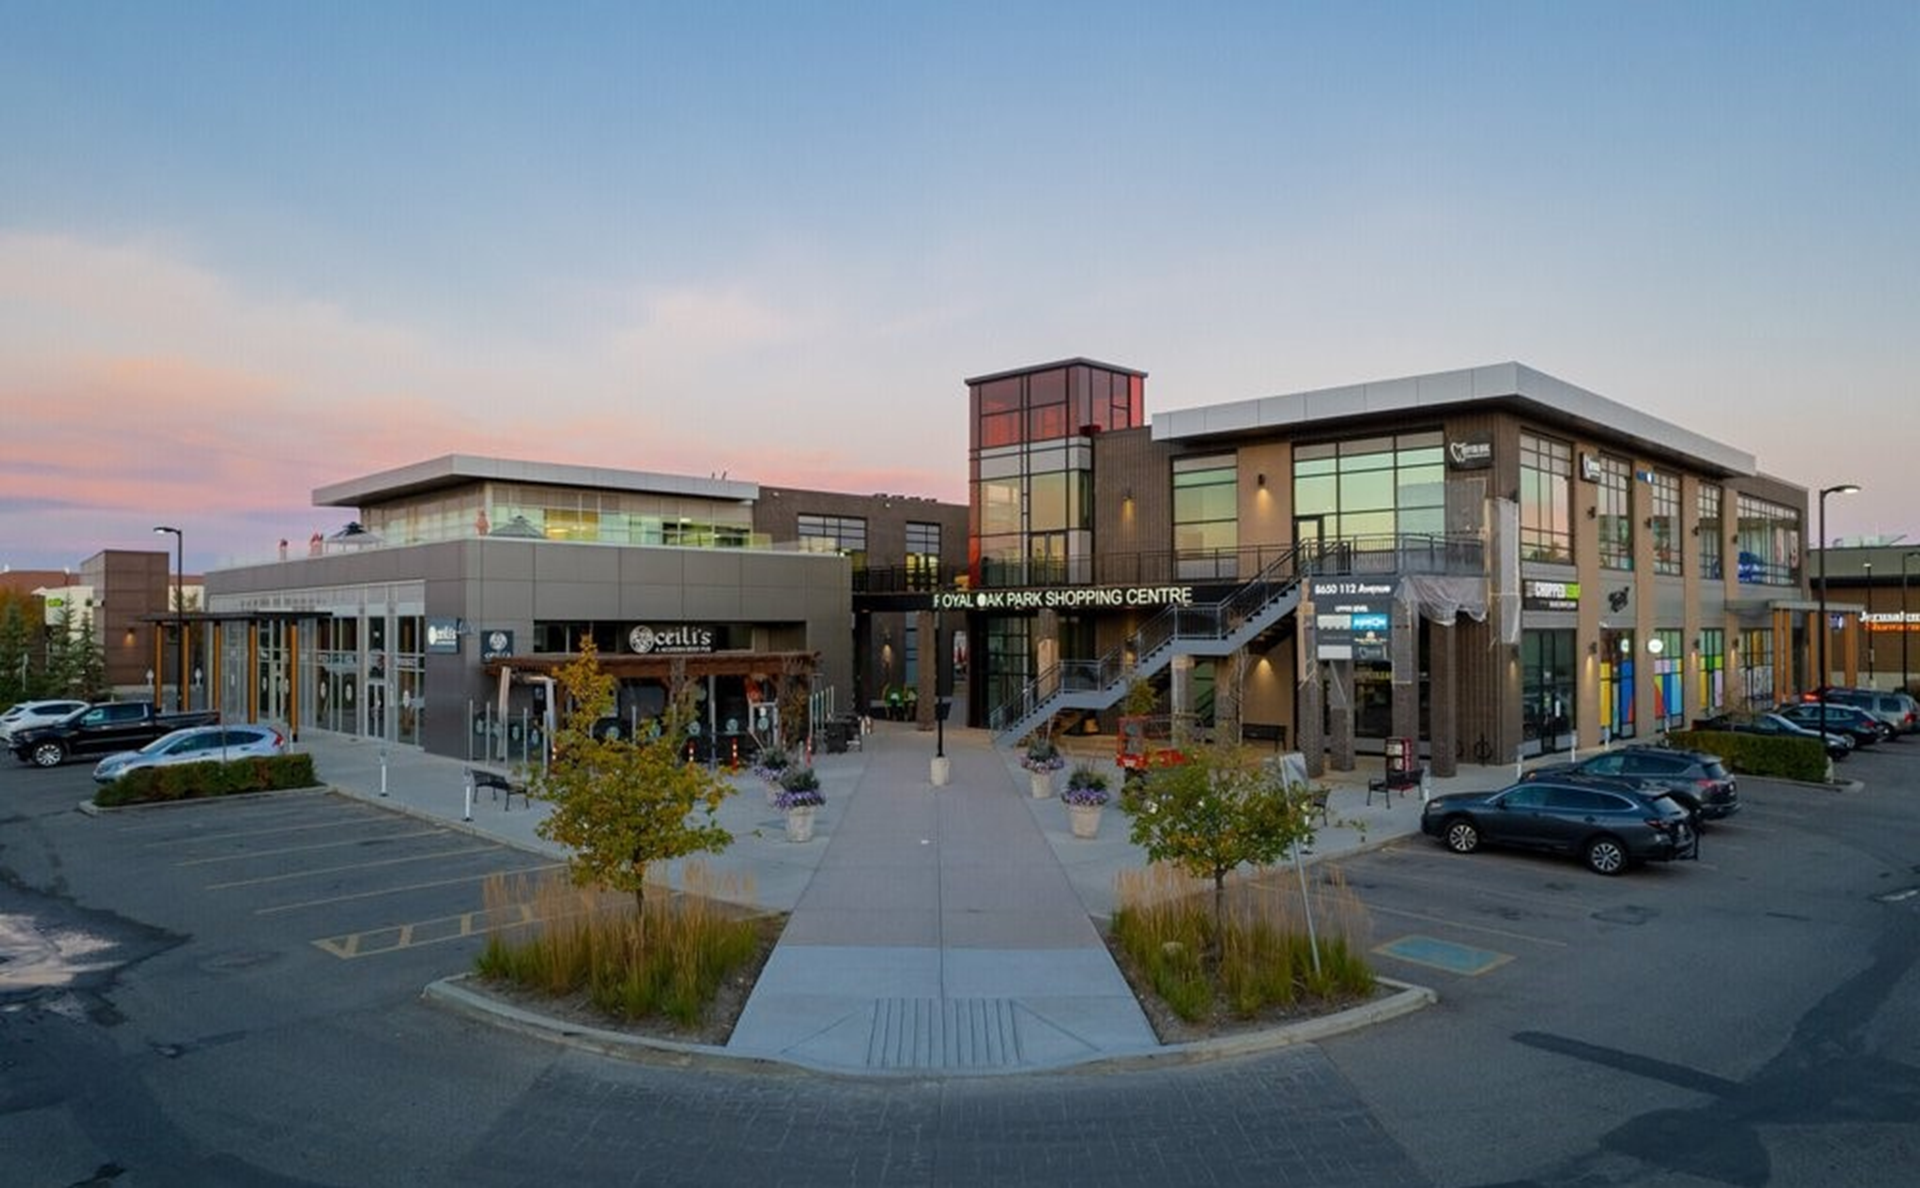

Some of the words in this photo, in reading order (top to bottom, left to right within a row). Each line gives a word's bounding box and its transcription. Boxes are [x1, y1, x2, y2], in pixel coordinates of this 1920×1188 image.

[976, 592, 1004, 607] OAK
[1006, 591, 1042, 606] PARK
[1045, 589, 1123, 606] SHOPPING
[1126, 587, 1193, 605] CENTRE
[1339, 584, 1357, 594] 112
[1358, 583, 1391, 595] Avenue
[655, 626, 712, 645] ceili's
